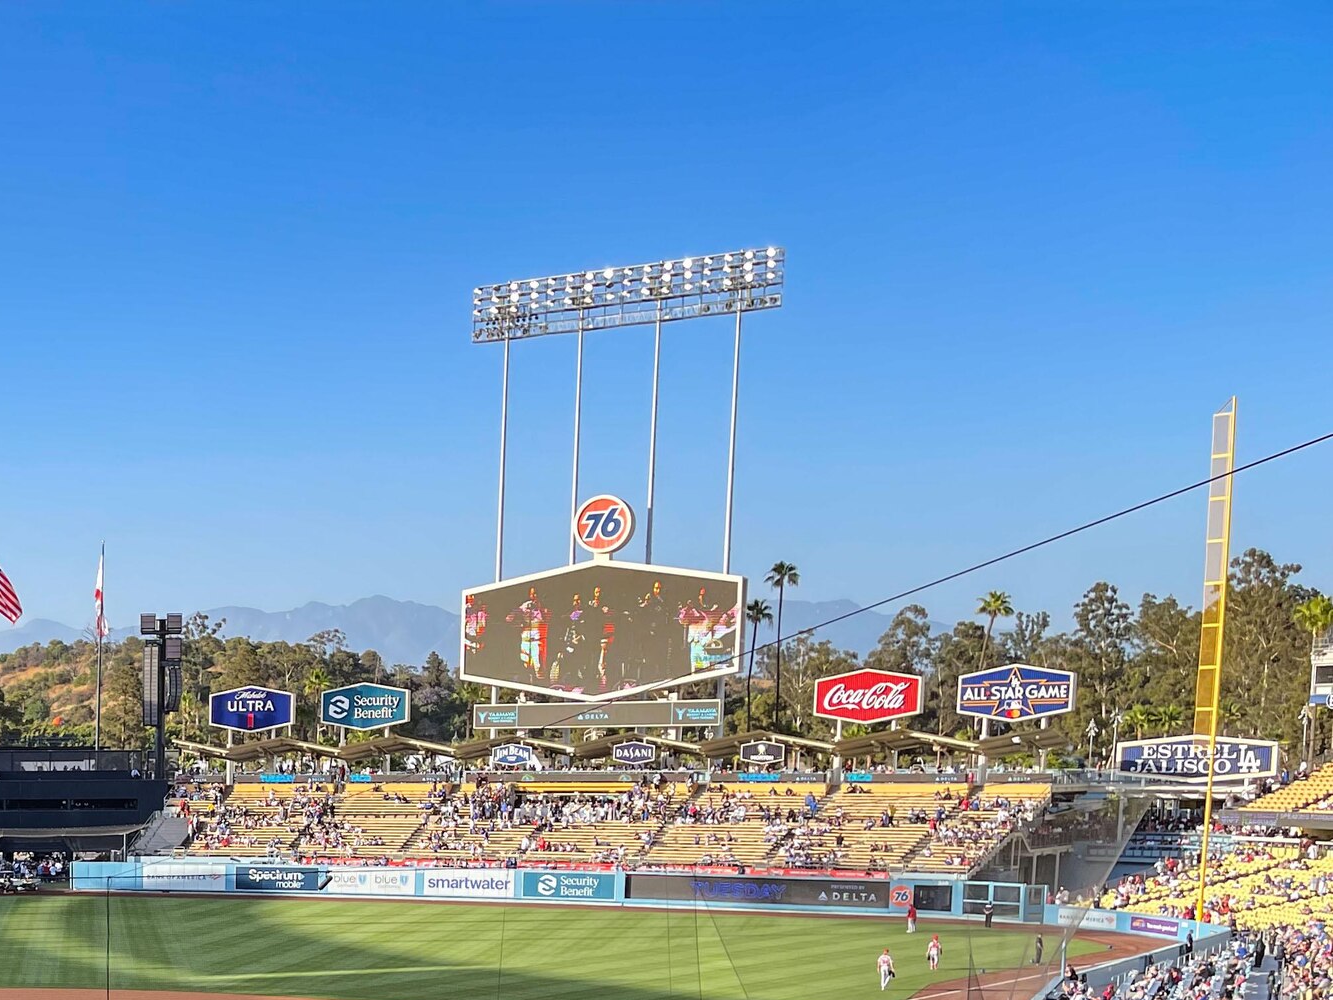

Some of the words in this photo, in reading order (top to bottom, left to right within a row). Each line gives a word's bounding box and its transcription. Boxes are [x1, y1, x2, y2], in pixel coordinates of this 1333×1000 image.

[581, 506, 623, 541] 76
[823, 681, 911, 710] Coca-Cola
[963, 687, 987, 700] ALL
[991, 686, 1023, 699] STAR
[1026, 685, 1068, 699] GAME
[227, 700, 275, 712] ULTRA
[354, 694, 400, 708] Security
[354, 706, 394, 719] Benefit
[509, 745, 530, 760] BEAM
[616, 747, 652, 759] DASANI
[1130, 759, 1232, 774] JALISCO
[248, 868, 301, 882] Spectrum
[333, 872, 356, 884] blue
[374, 874, 397, 885] blue
[560, 875, 599, 889] Security
[427, 875, 511, 891] smartwater
[690, 880, 786, 900] TUESDAY
[560, 885, 595, 897] Benefit
[832, 892, 877, 902] DELTA
[893, 889, 910, 902] 76
